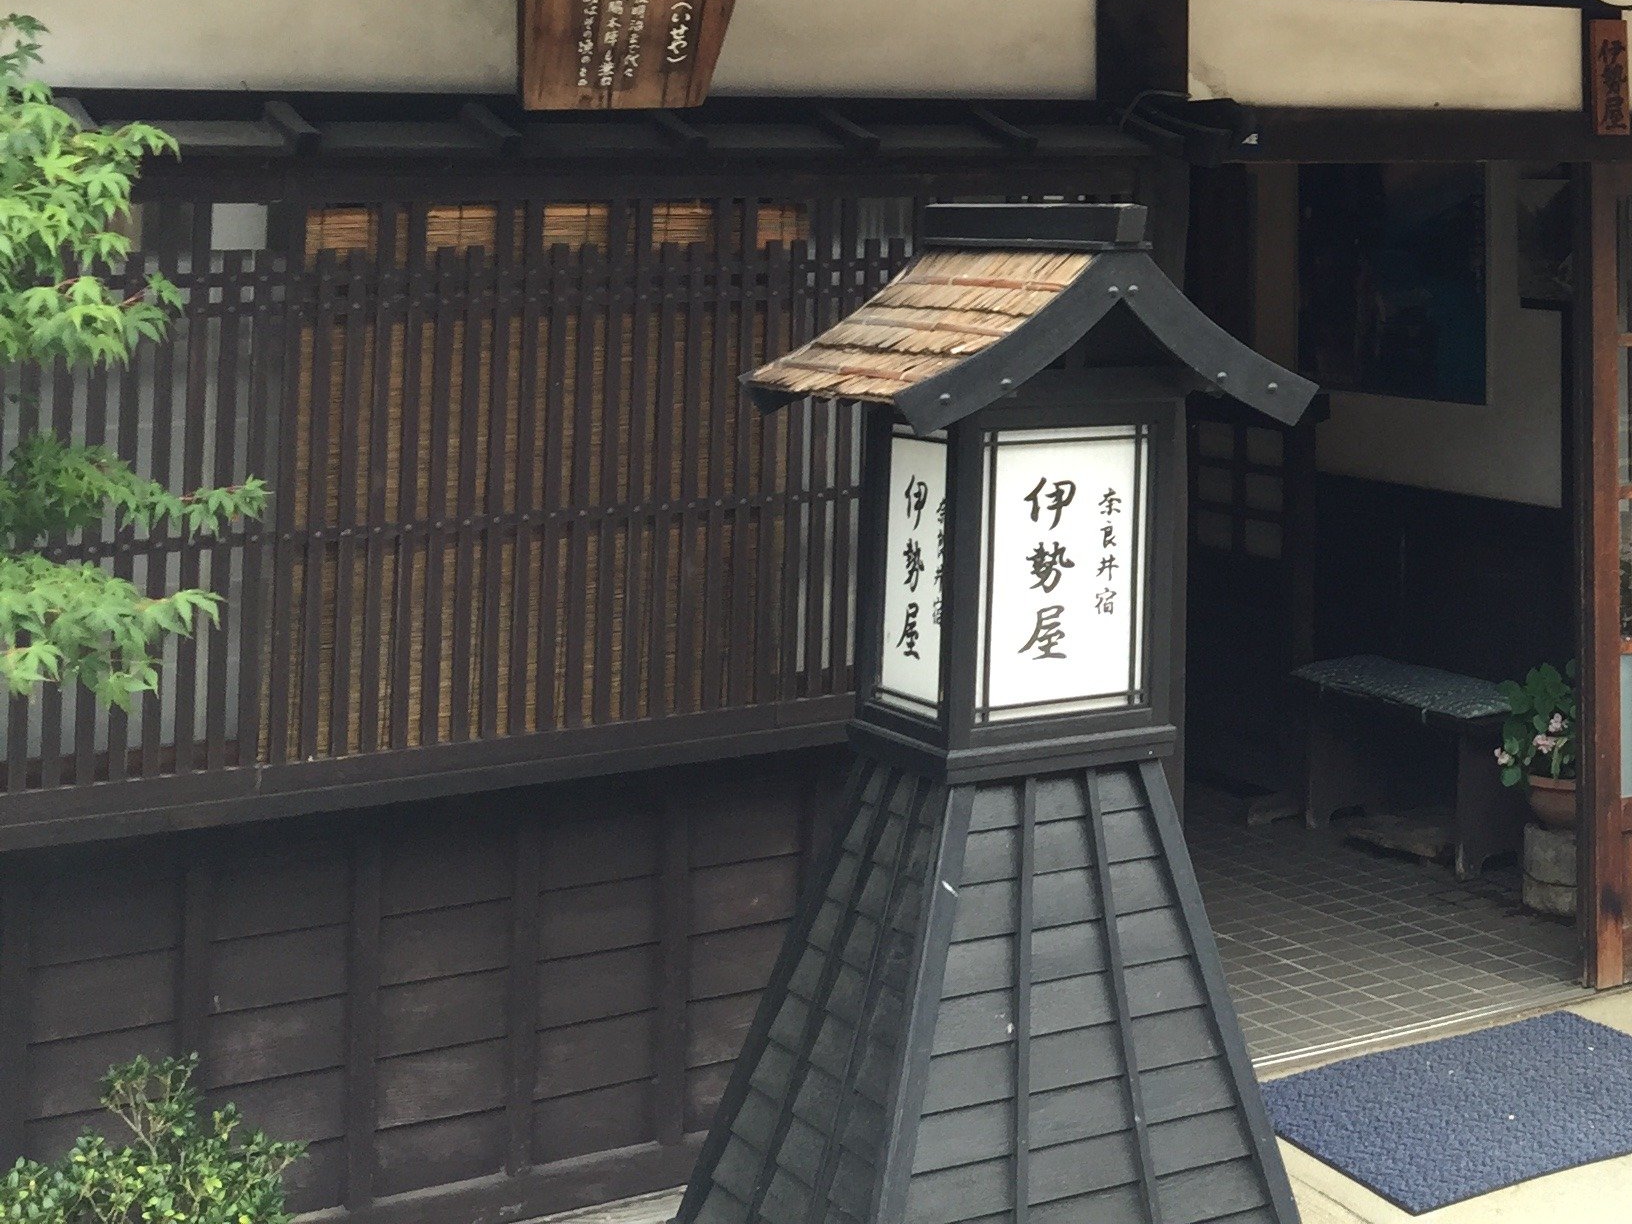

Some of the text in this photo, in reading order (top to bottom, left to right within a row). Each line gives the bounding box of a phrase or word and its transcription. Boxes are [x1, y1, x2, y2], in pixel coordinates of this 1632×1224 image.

[1597, 38, 1628, 131] 伊勢屋
[896, 474, 929, 661] 伊勢屋
[1017, 476, 1077, 661] 伊勢屋
[1094, 487, 1122, 616] 奈良井宿
